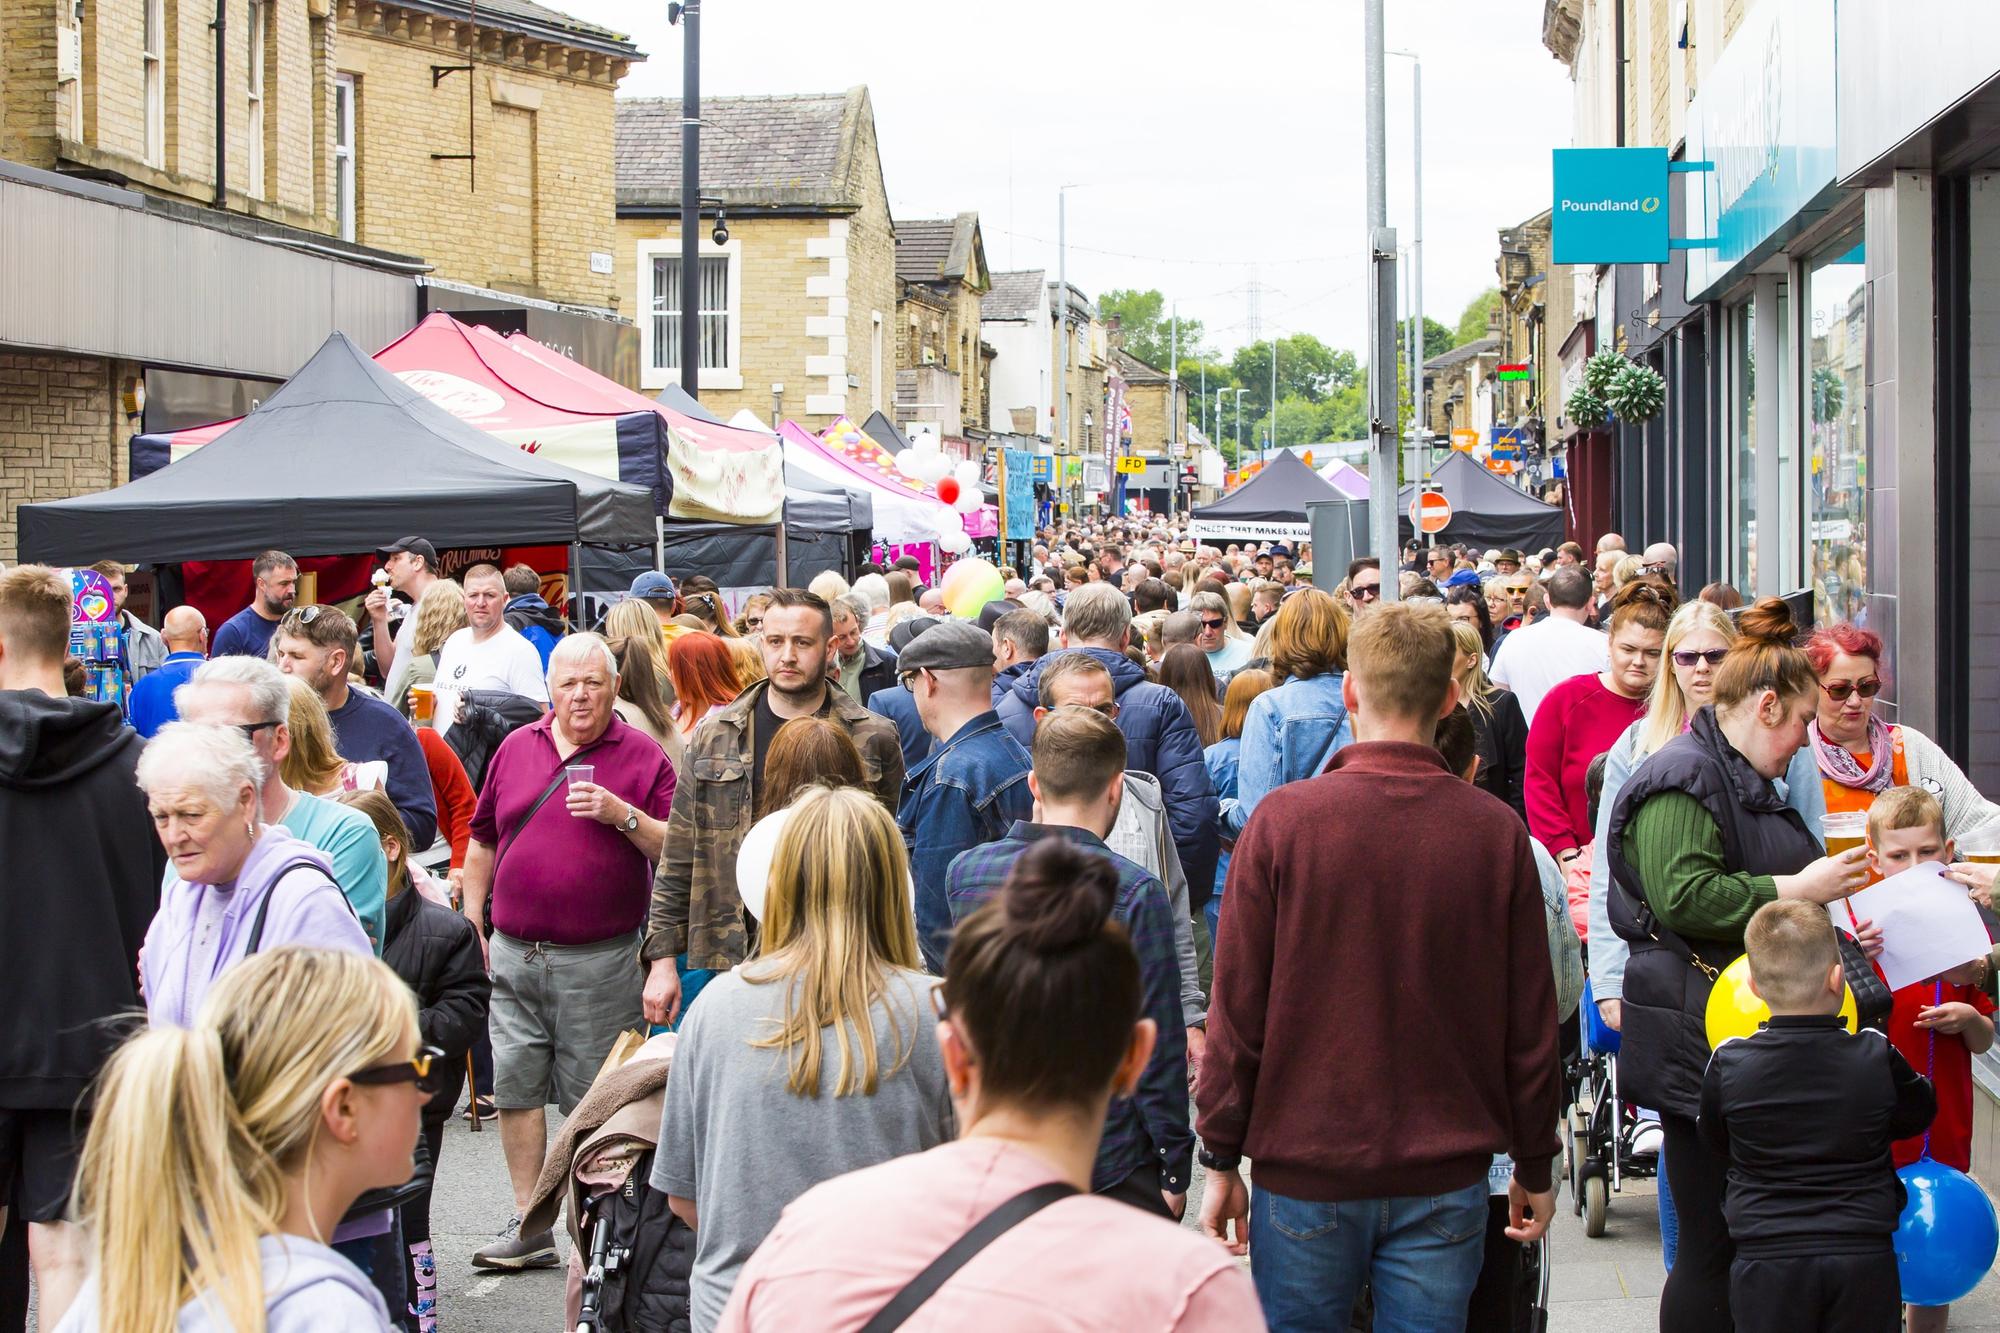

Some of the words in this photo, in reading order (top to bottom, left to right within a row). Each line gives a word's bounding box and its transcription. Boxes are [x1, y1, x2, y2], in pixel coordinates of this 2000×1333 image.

[1561, 199, 1639, 212] Poundland
[1230, 526, 1252, 534] THAT
[1255, 528, 1288, 536] MAKES
[1292, 528, 1310, 536] YOU
